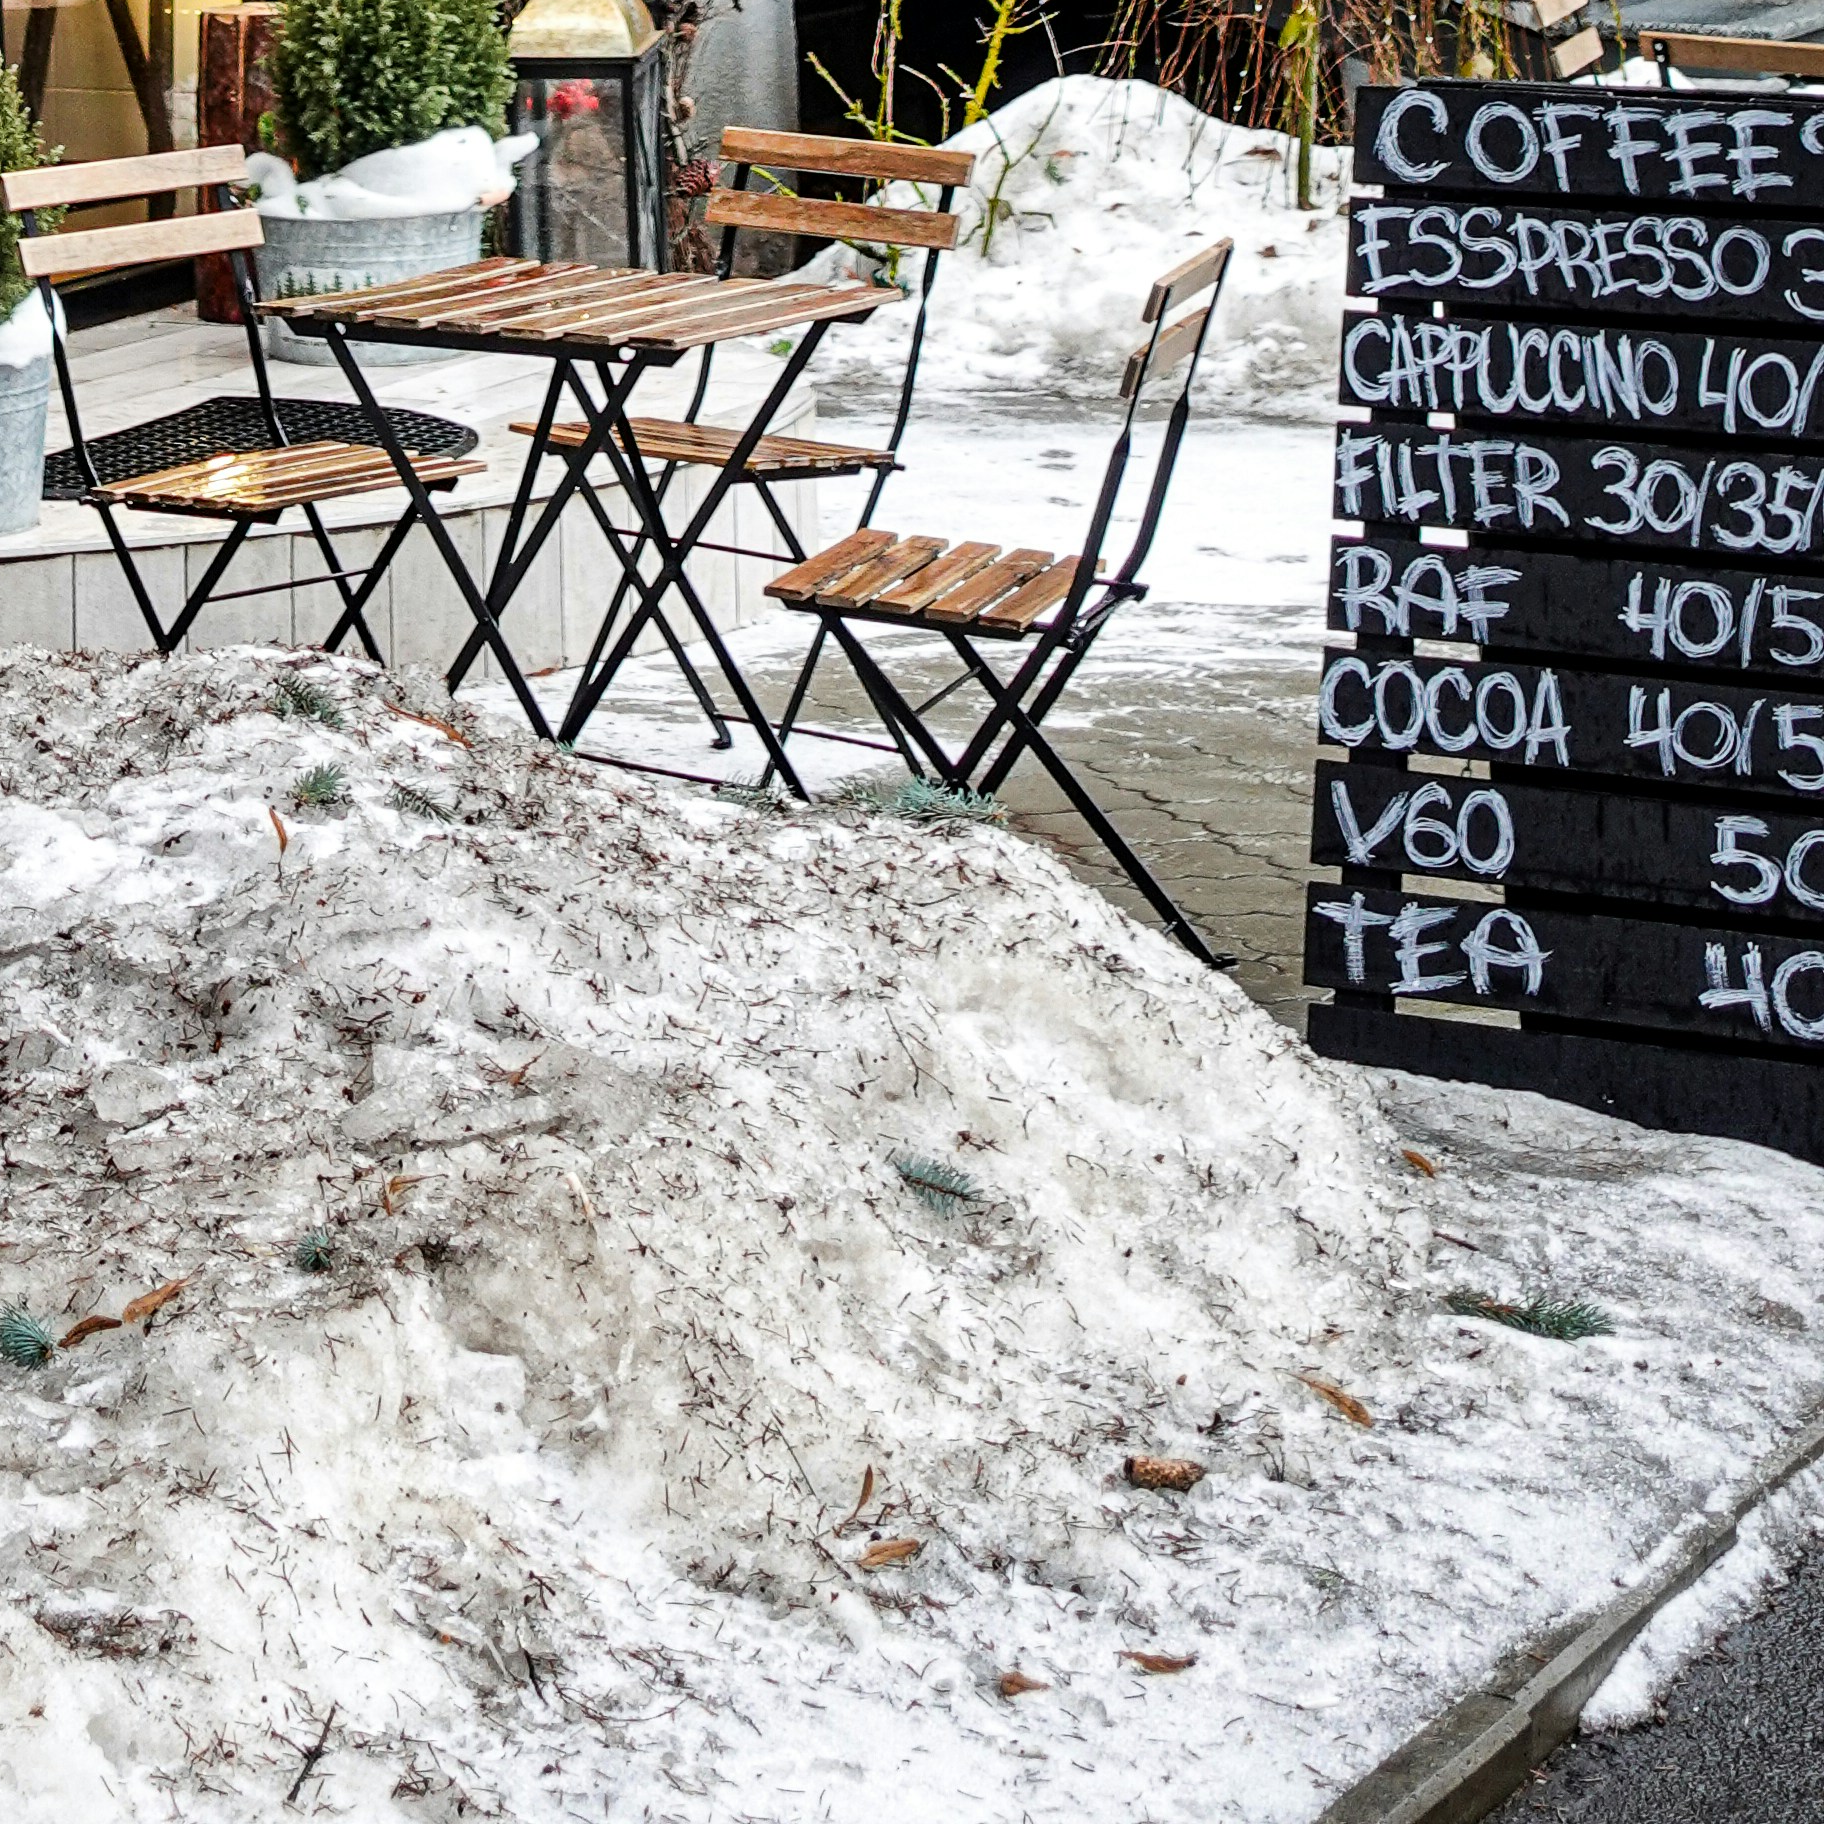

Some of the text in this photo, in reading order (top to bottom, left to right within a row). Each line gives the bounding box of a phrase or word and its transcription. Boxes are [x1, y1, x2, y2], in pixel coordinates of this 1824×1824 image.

[1354, 204, 1771, 301] ESSPRESSO
[1344, 314, 1679, 419] CAPPUCCINO
[1335, 429, 1571, 528] FILTER
[1332, 545, 1523, 644] RAF
[1318, 657, 1572, 767] COCOA
[1330, 780, 1515, 879] V60
[1312, 891, 1554, 996] TEA
